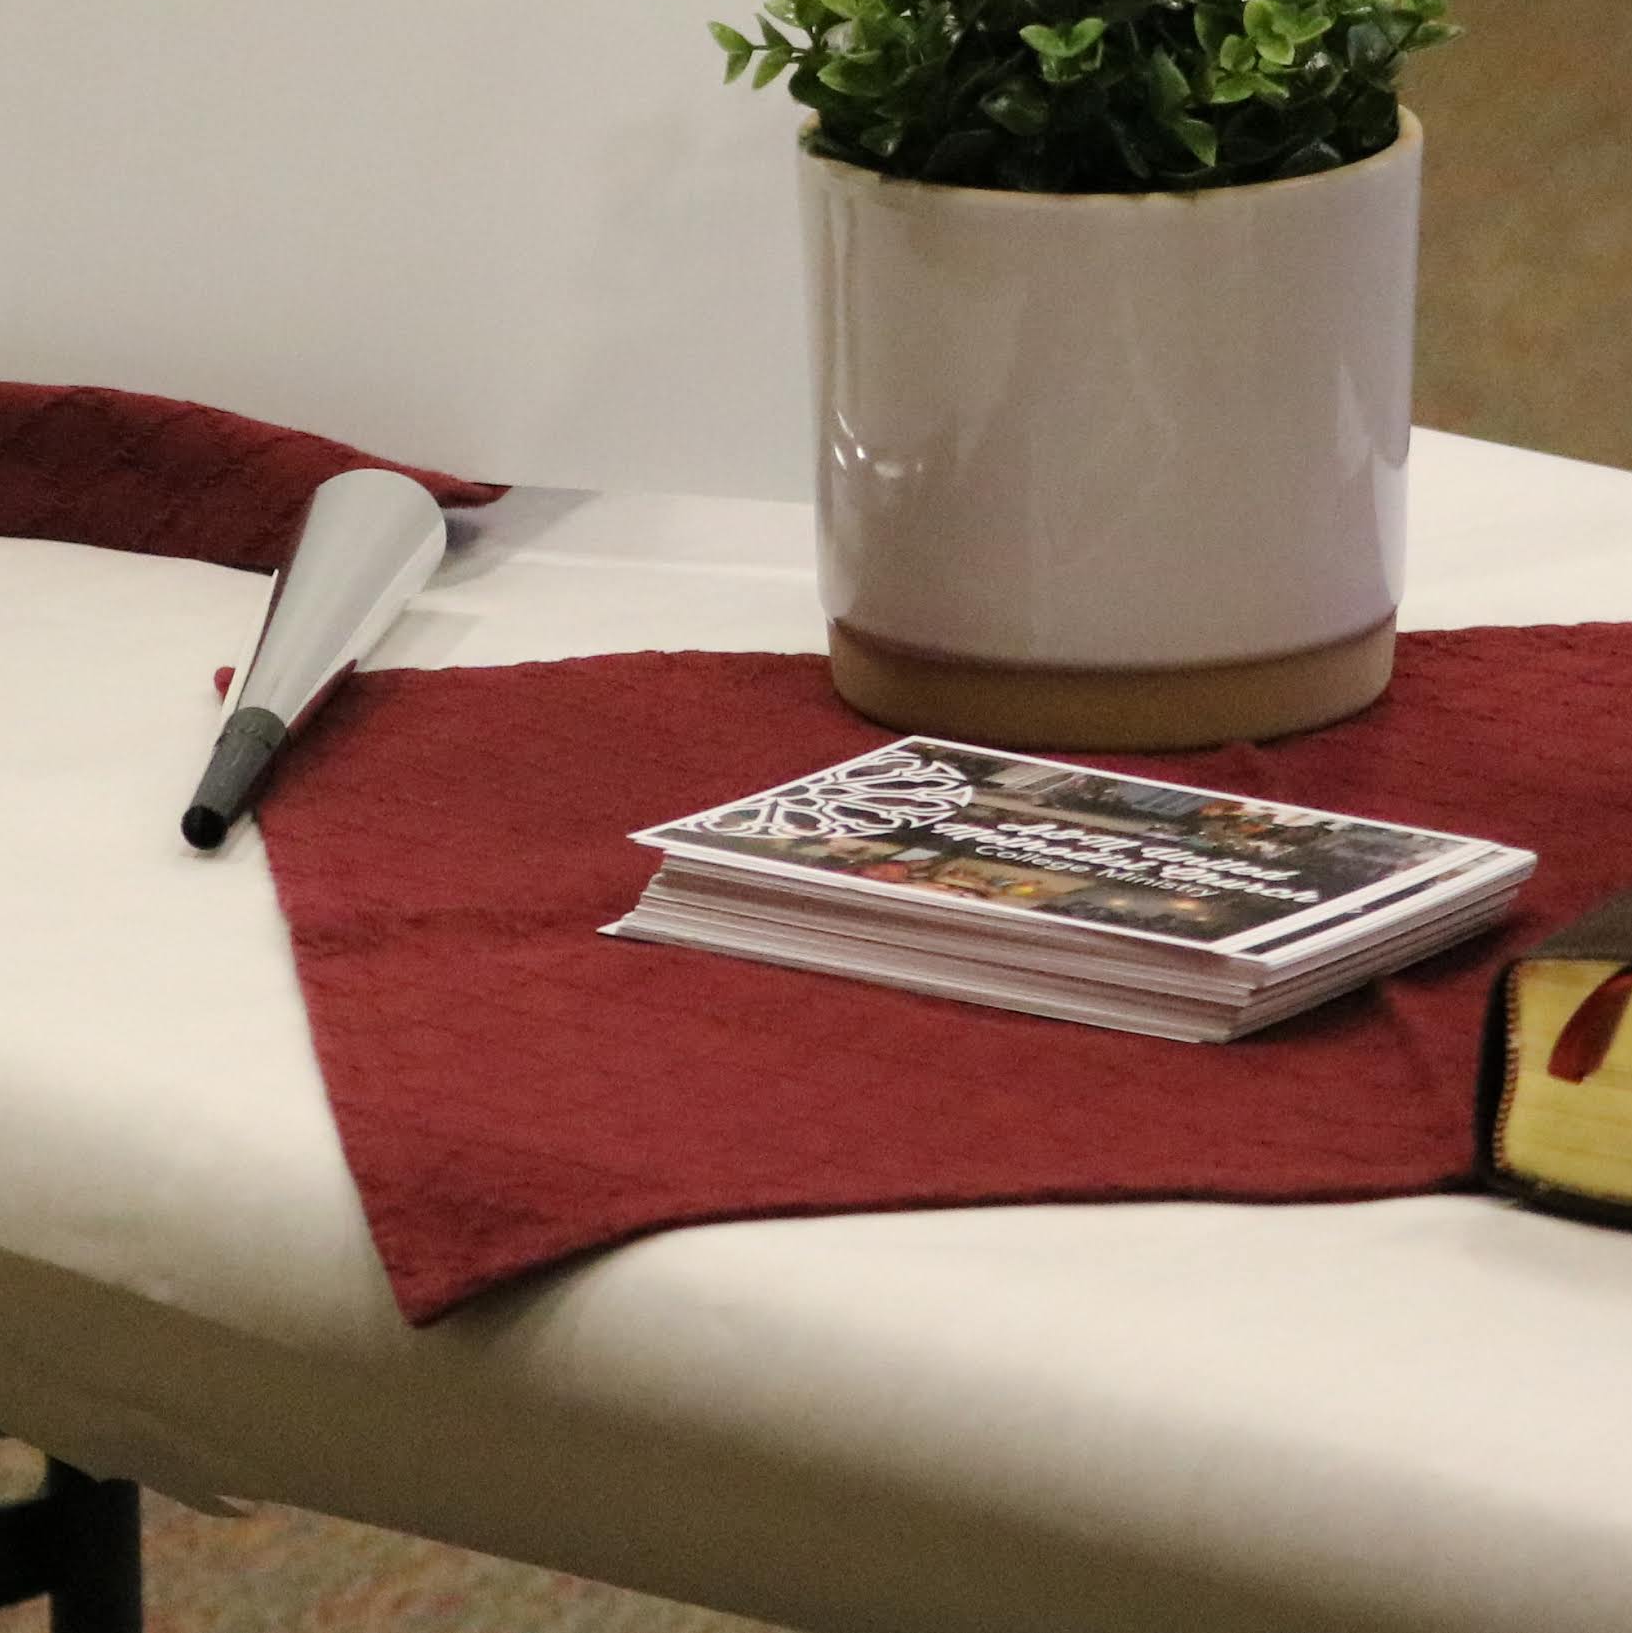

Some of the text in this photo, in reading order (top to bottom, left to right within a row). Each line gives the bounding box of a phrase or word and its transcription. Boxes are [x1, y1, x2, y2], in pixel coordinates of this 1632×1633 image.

[975, 845, 1222, 898] College Ministry
[1140, 846, 1301, 881] United
